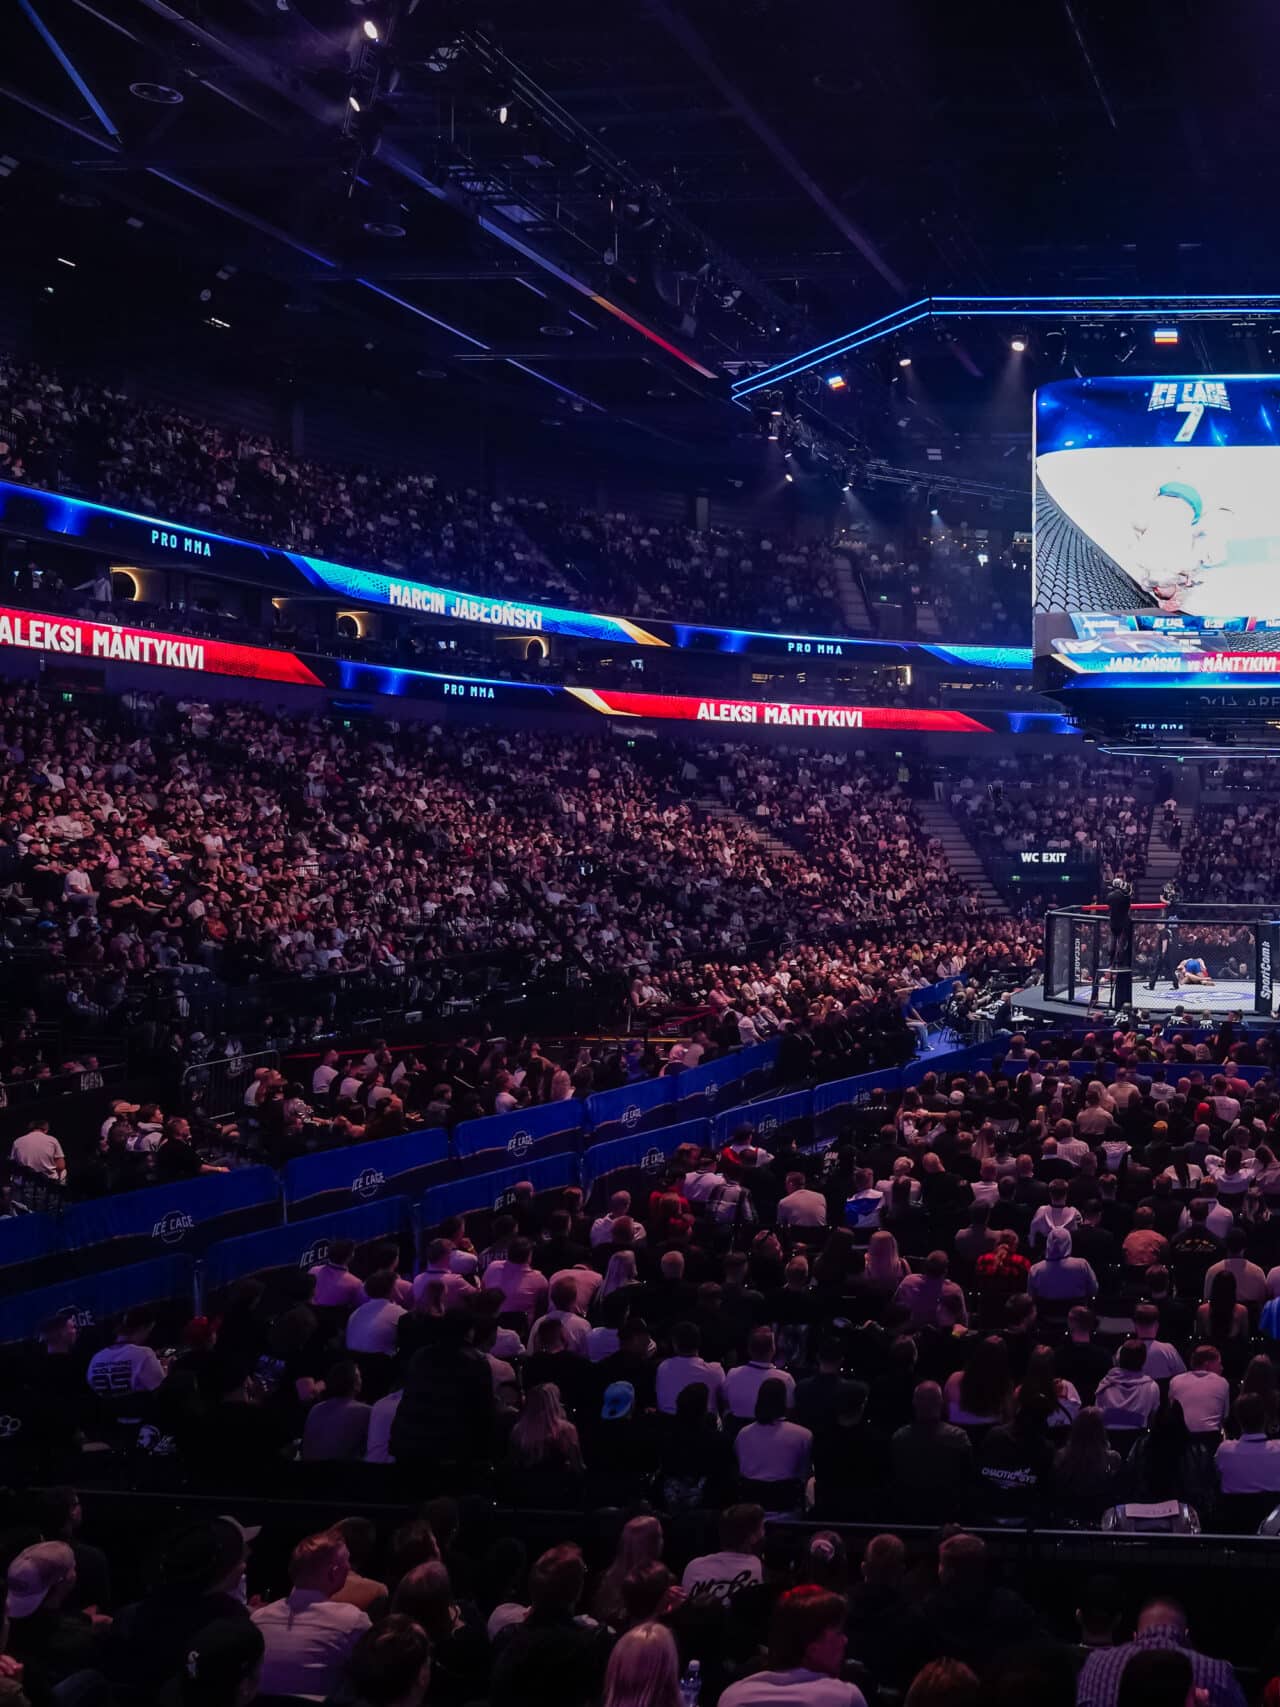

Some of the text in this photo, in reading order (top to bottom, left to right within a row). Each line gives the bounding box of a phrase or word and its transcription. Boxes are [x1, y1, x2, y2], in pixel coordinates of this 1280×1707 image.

[1174, 402, 1204, 442] 7
[151, 530, 212, 557] PRO MMA
[389, 583, 543, 630] MARCIN JABŁOŃSKI
[0, 615, 205, 670] ALEKSI MÄNTYKIVI
[788, 642, 843, 655] PRO MMA
[443, 683, 495, 699] PRO MMA
[697, 702, 863, 728] ALEKSI MÄNTYKIVI
[1020, 851, 1068, 863] WC EXIT
[151, 1215, 196, 1239] ICE CAGE
